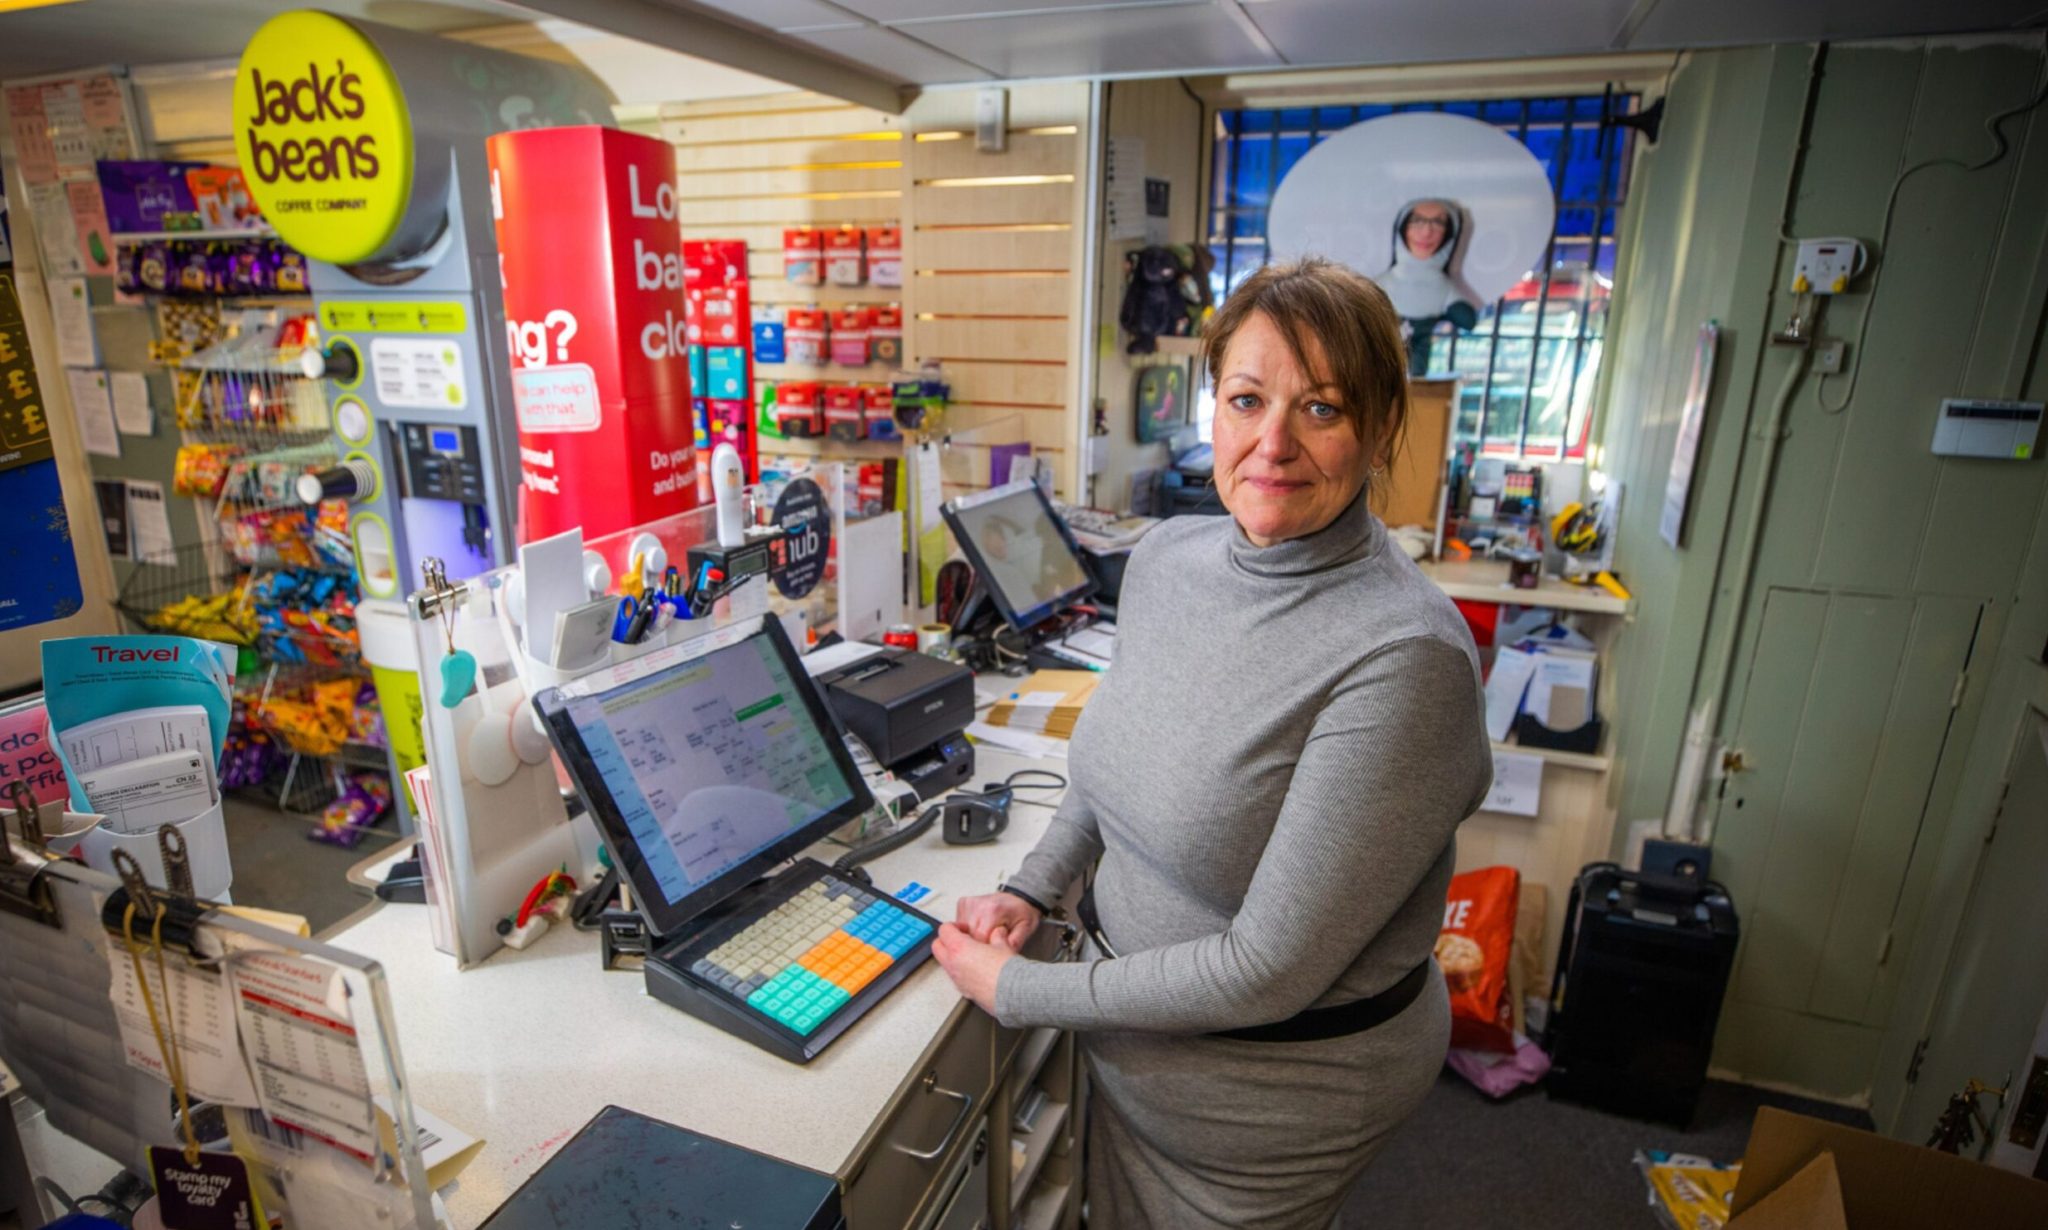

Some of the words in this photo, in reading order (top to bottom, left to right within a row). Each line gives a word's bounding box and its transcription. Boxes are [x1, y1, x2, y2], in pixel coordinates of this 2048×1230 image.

[250, 59, 365, 127] Jack's
[248, 128, 379, 184] beans
[276, 200, 313, 213] COFFEE
[317, 199, 367, 212] COMPANY
[651, 451, 670, 470] Do
[90, 646, 180, 663] Travel
[91, 788, 119, 800] CUSTOMS
[120, 782, 161, 795] DECLARATION
[209, 1174, 232, 1190] my
